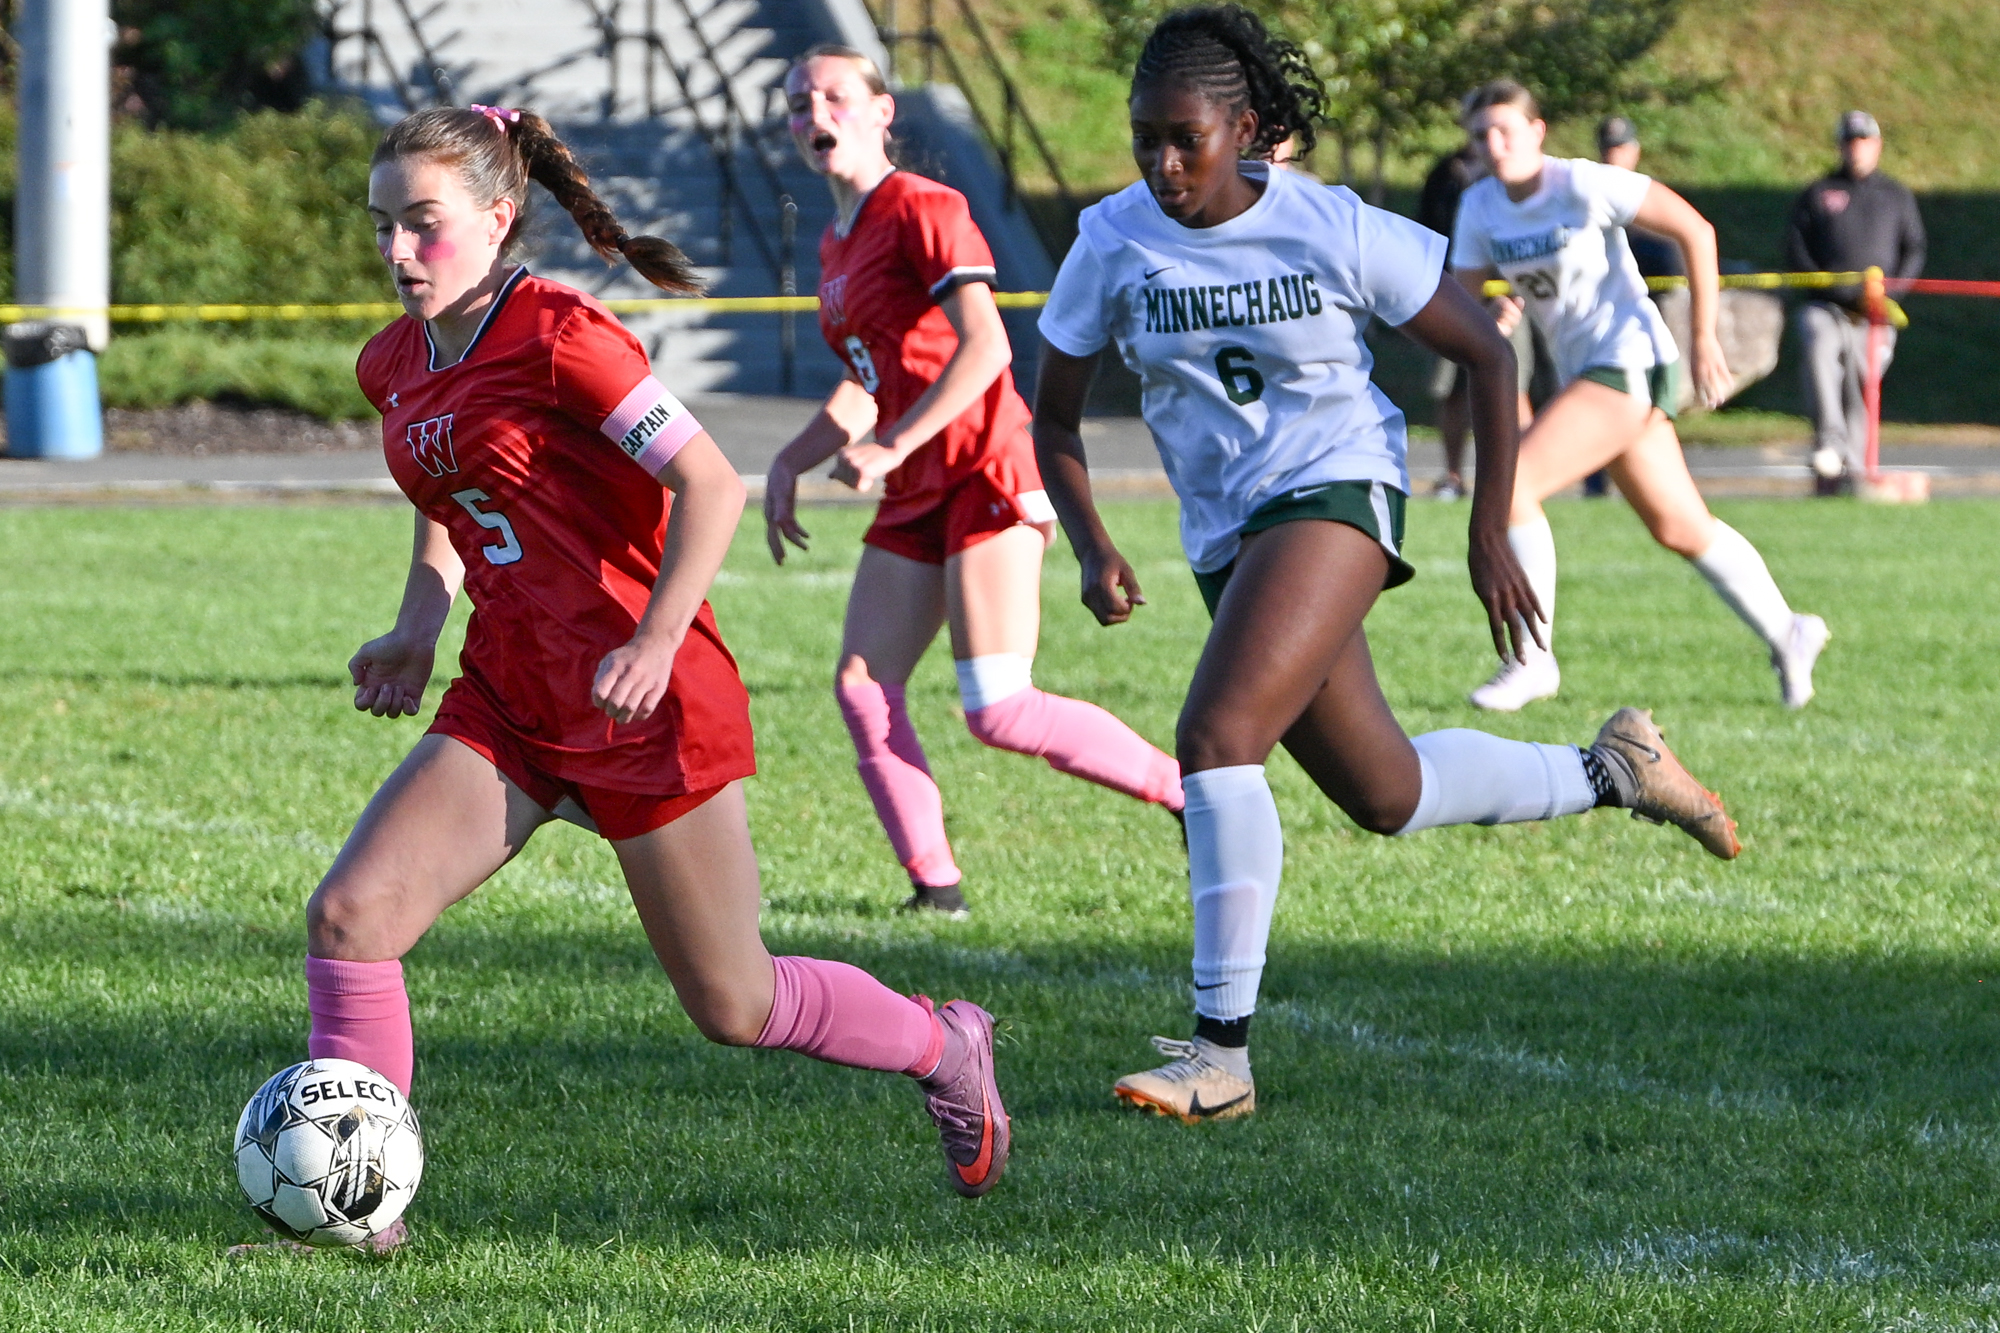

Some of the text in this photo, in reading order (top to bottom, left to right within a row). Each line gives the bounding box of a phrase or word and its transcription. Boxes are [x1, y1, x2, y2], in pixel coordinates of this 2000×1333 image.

[1144, 273, 1323, 334] MINNECHAUG
[1214, 346, 1265, 406] 6
[406, 413, 459, 478] W
[620, 403, 671, 456] CAPTAIN
[451, 488, 523, 566] 5
[300, 1080, 397, 1107] SELECT
